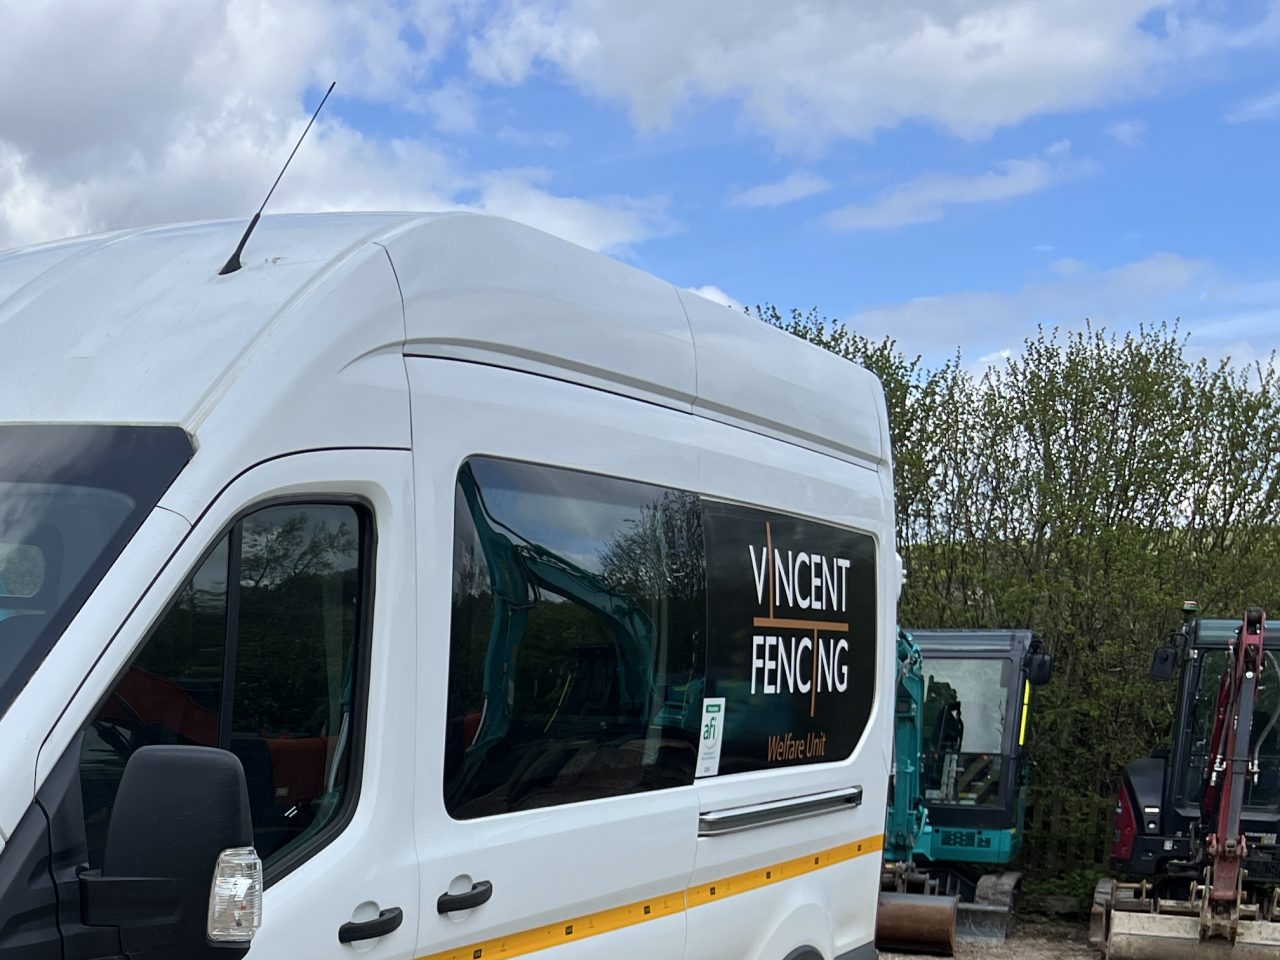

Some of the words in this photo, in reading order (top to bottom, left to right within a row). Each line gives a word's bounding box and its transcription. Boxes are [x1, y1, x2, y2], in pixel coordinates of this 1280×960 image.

[749, 522, 850, 612] VINCENT
[751, 635, 849, 717] FENCING
[768, 732, 805, 761] Welfare
[806, 731, 826, 758] Unit
